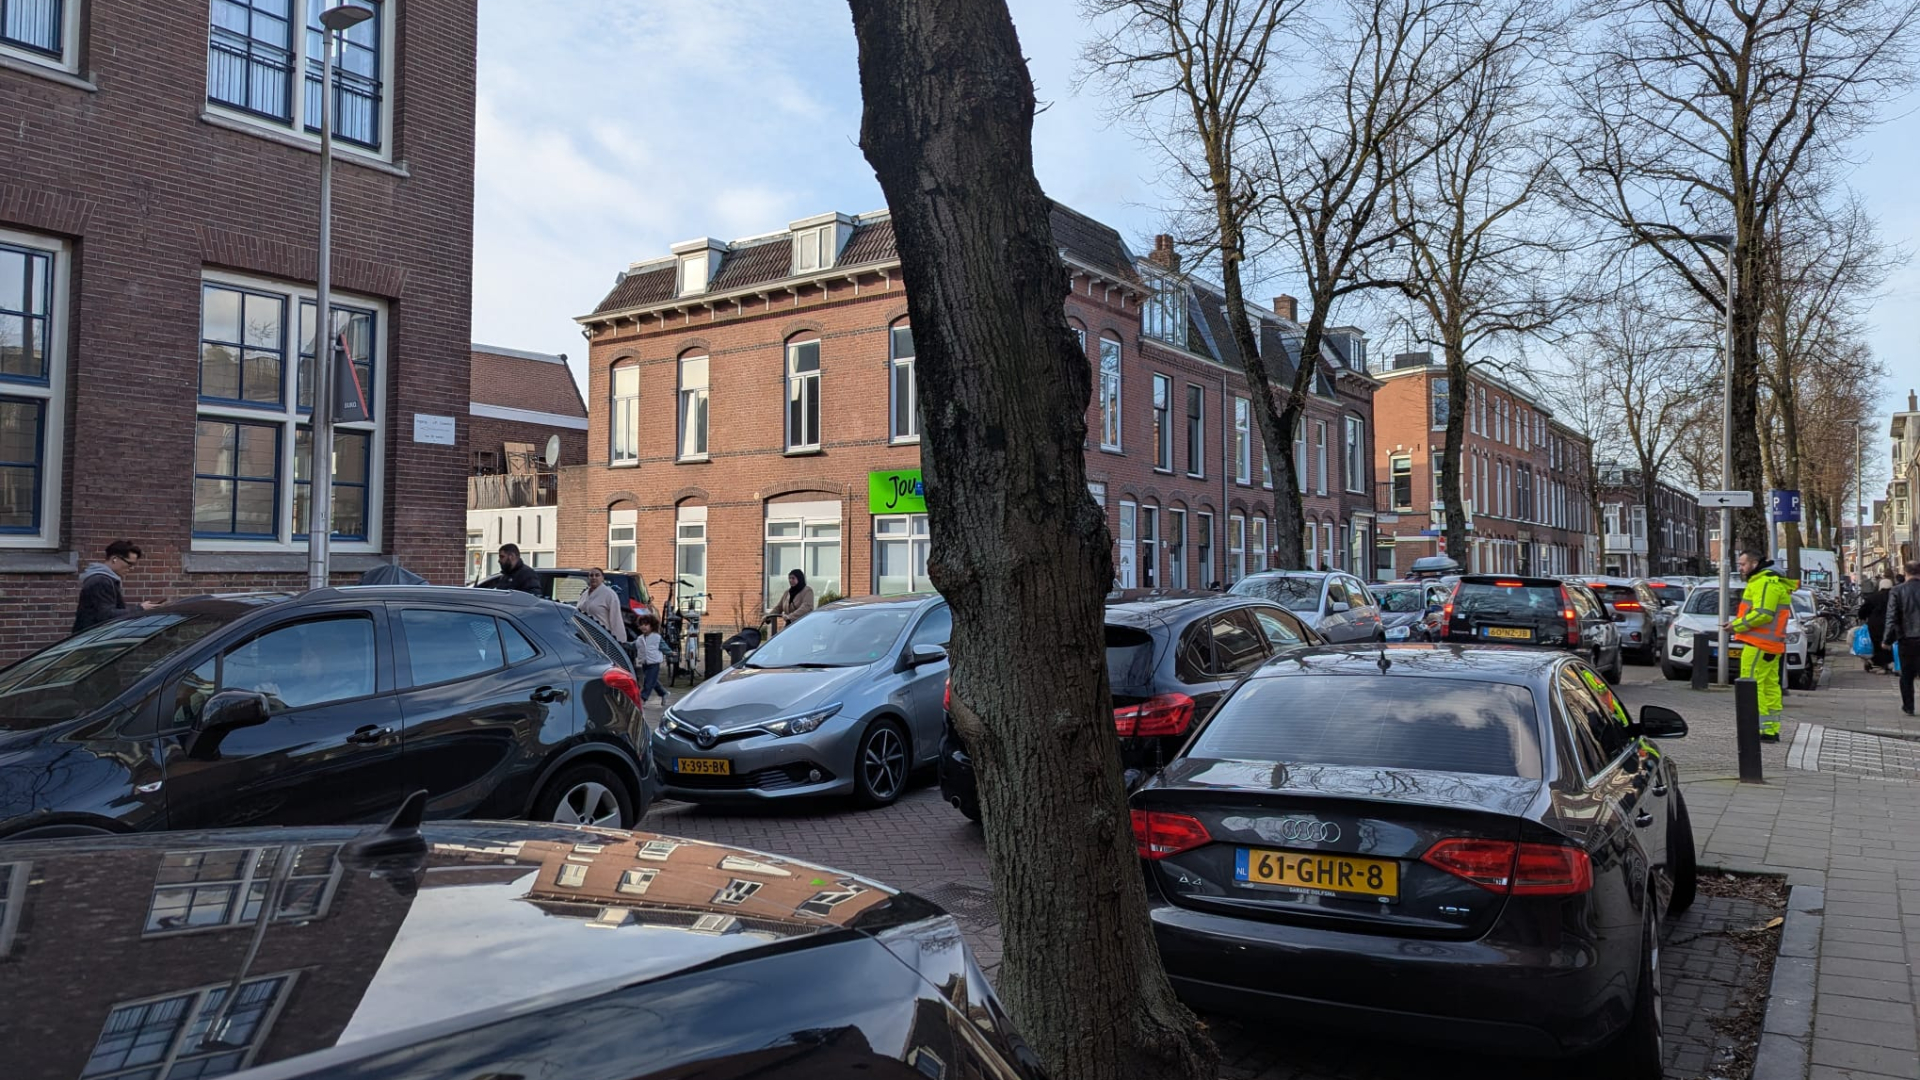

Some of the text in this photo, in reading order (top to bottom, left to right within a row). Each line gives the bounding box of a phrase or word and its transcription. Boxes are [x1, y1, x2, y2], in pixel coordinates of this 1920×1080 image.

[1773, 497, 1780, 508] P
[1792, 497, 1799, 508] P
[681, 760, 726, 773] X-395-BK
[1236, 868, 1247, 876] NL
[1258, 854, 1384, 890] 61-GHR-8
